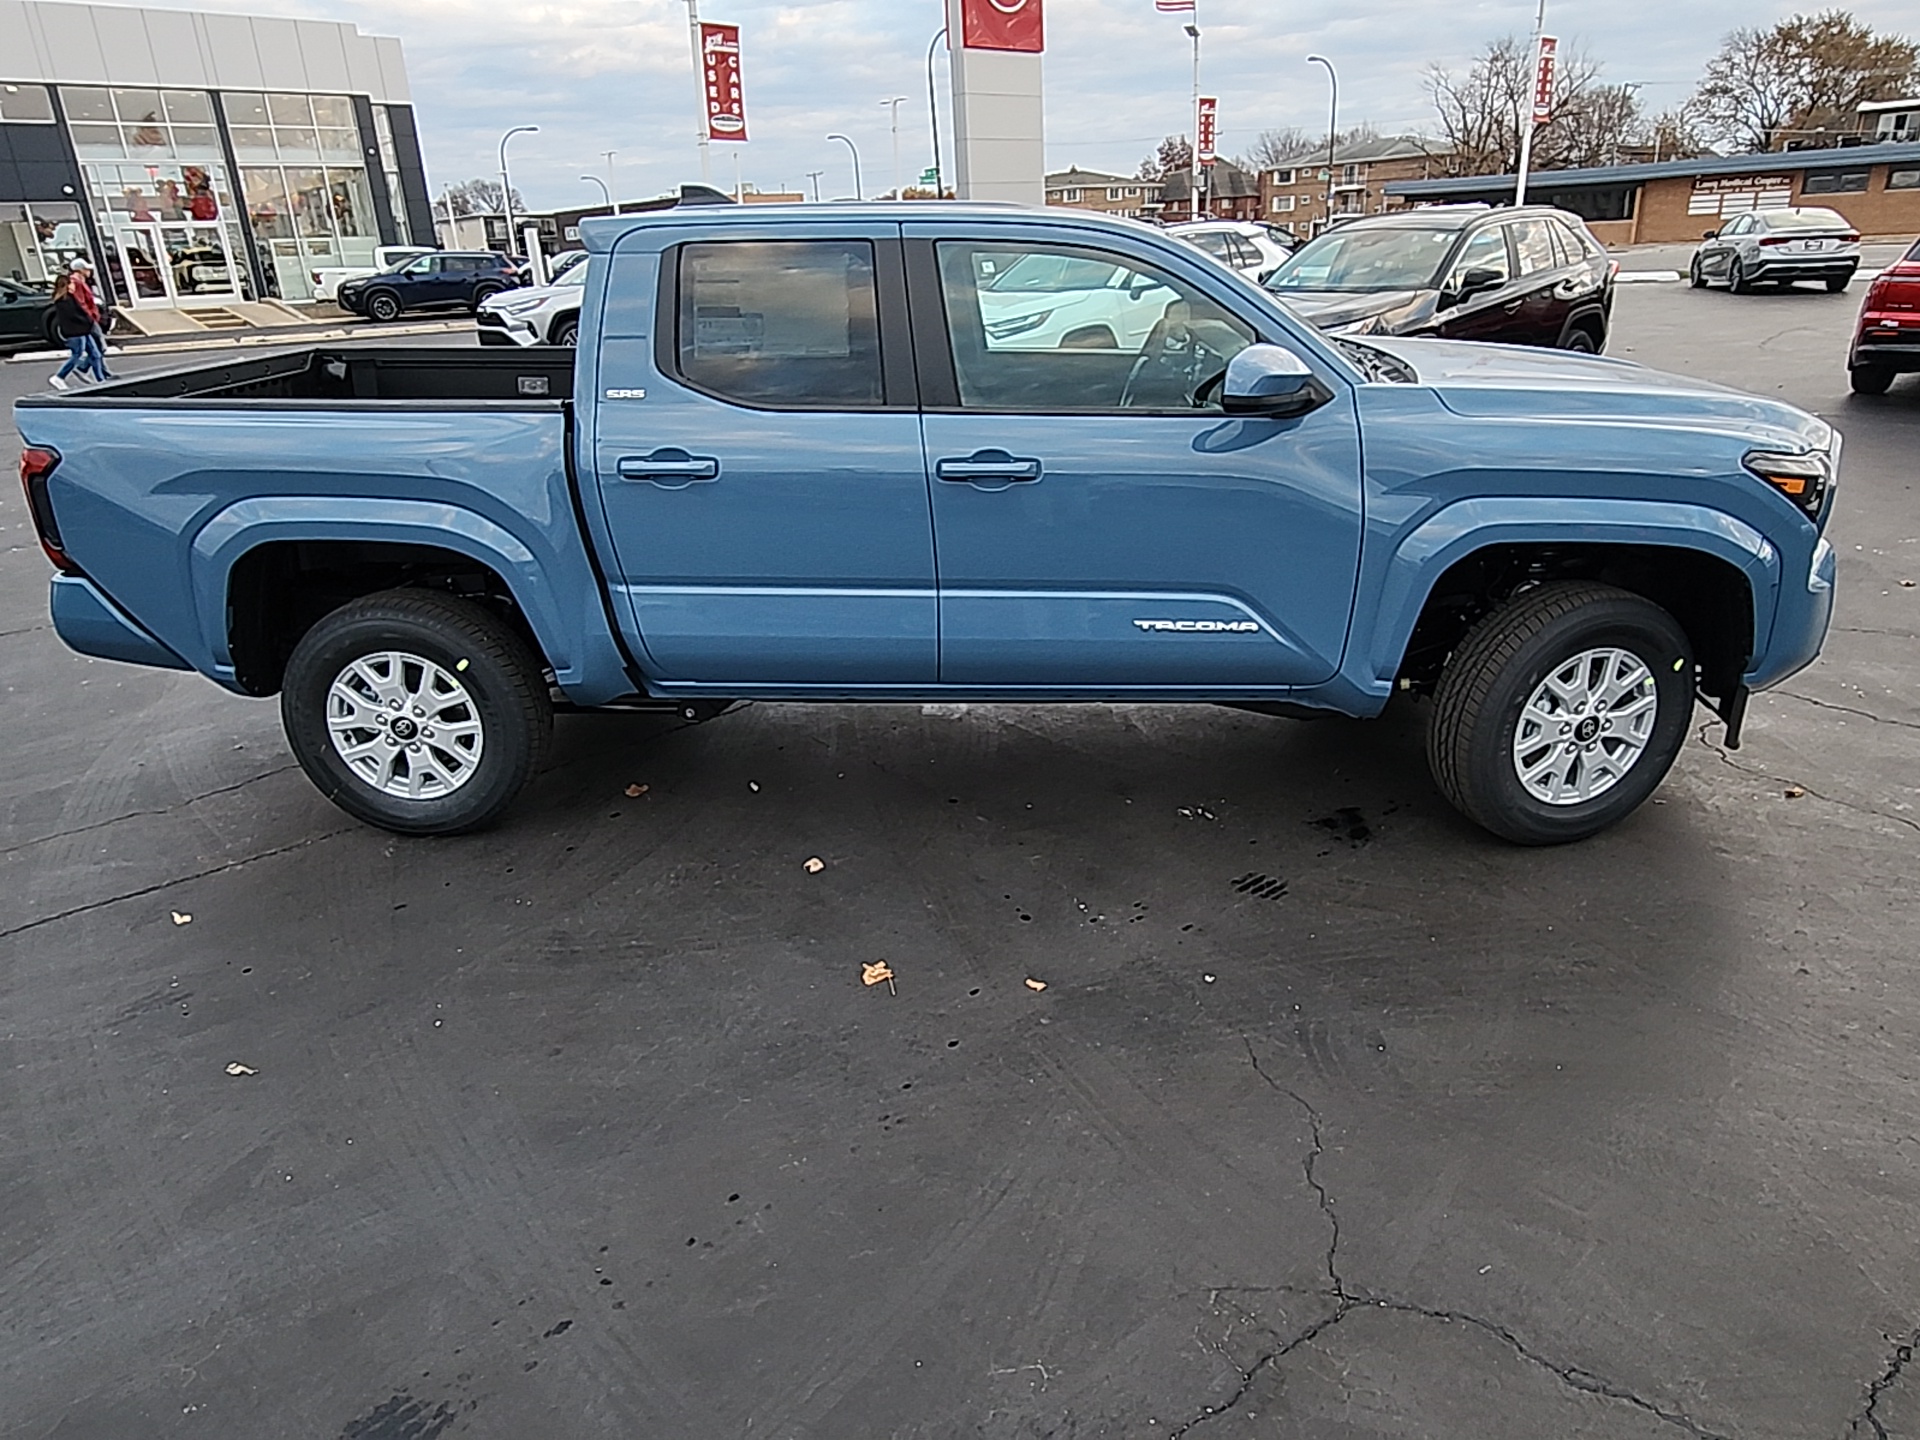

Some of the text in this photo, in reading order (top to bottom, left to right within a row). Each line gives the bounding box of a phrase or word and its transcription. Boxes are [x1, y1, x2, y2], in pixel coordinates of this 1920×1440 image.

[706, 54, 720, 114] USED
[728, 56, 740, 115] CARS
[1133, 620, 1259, 631] TACOMA
